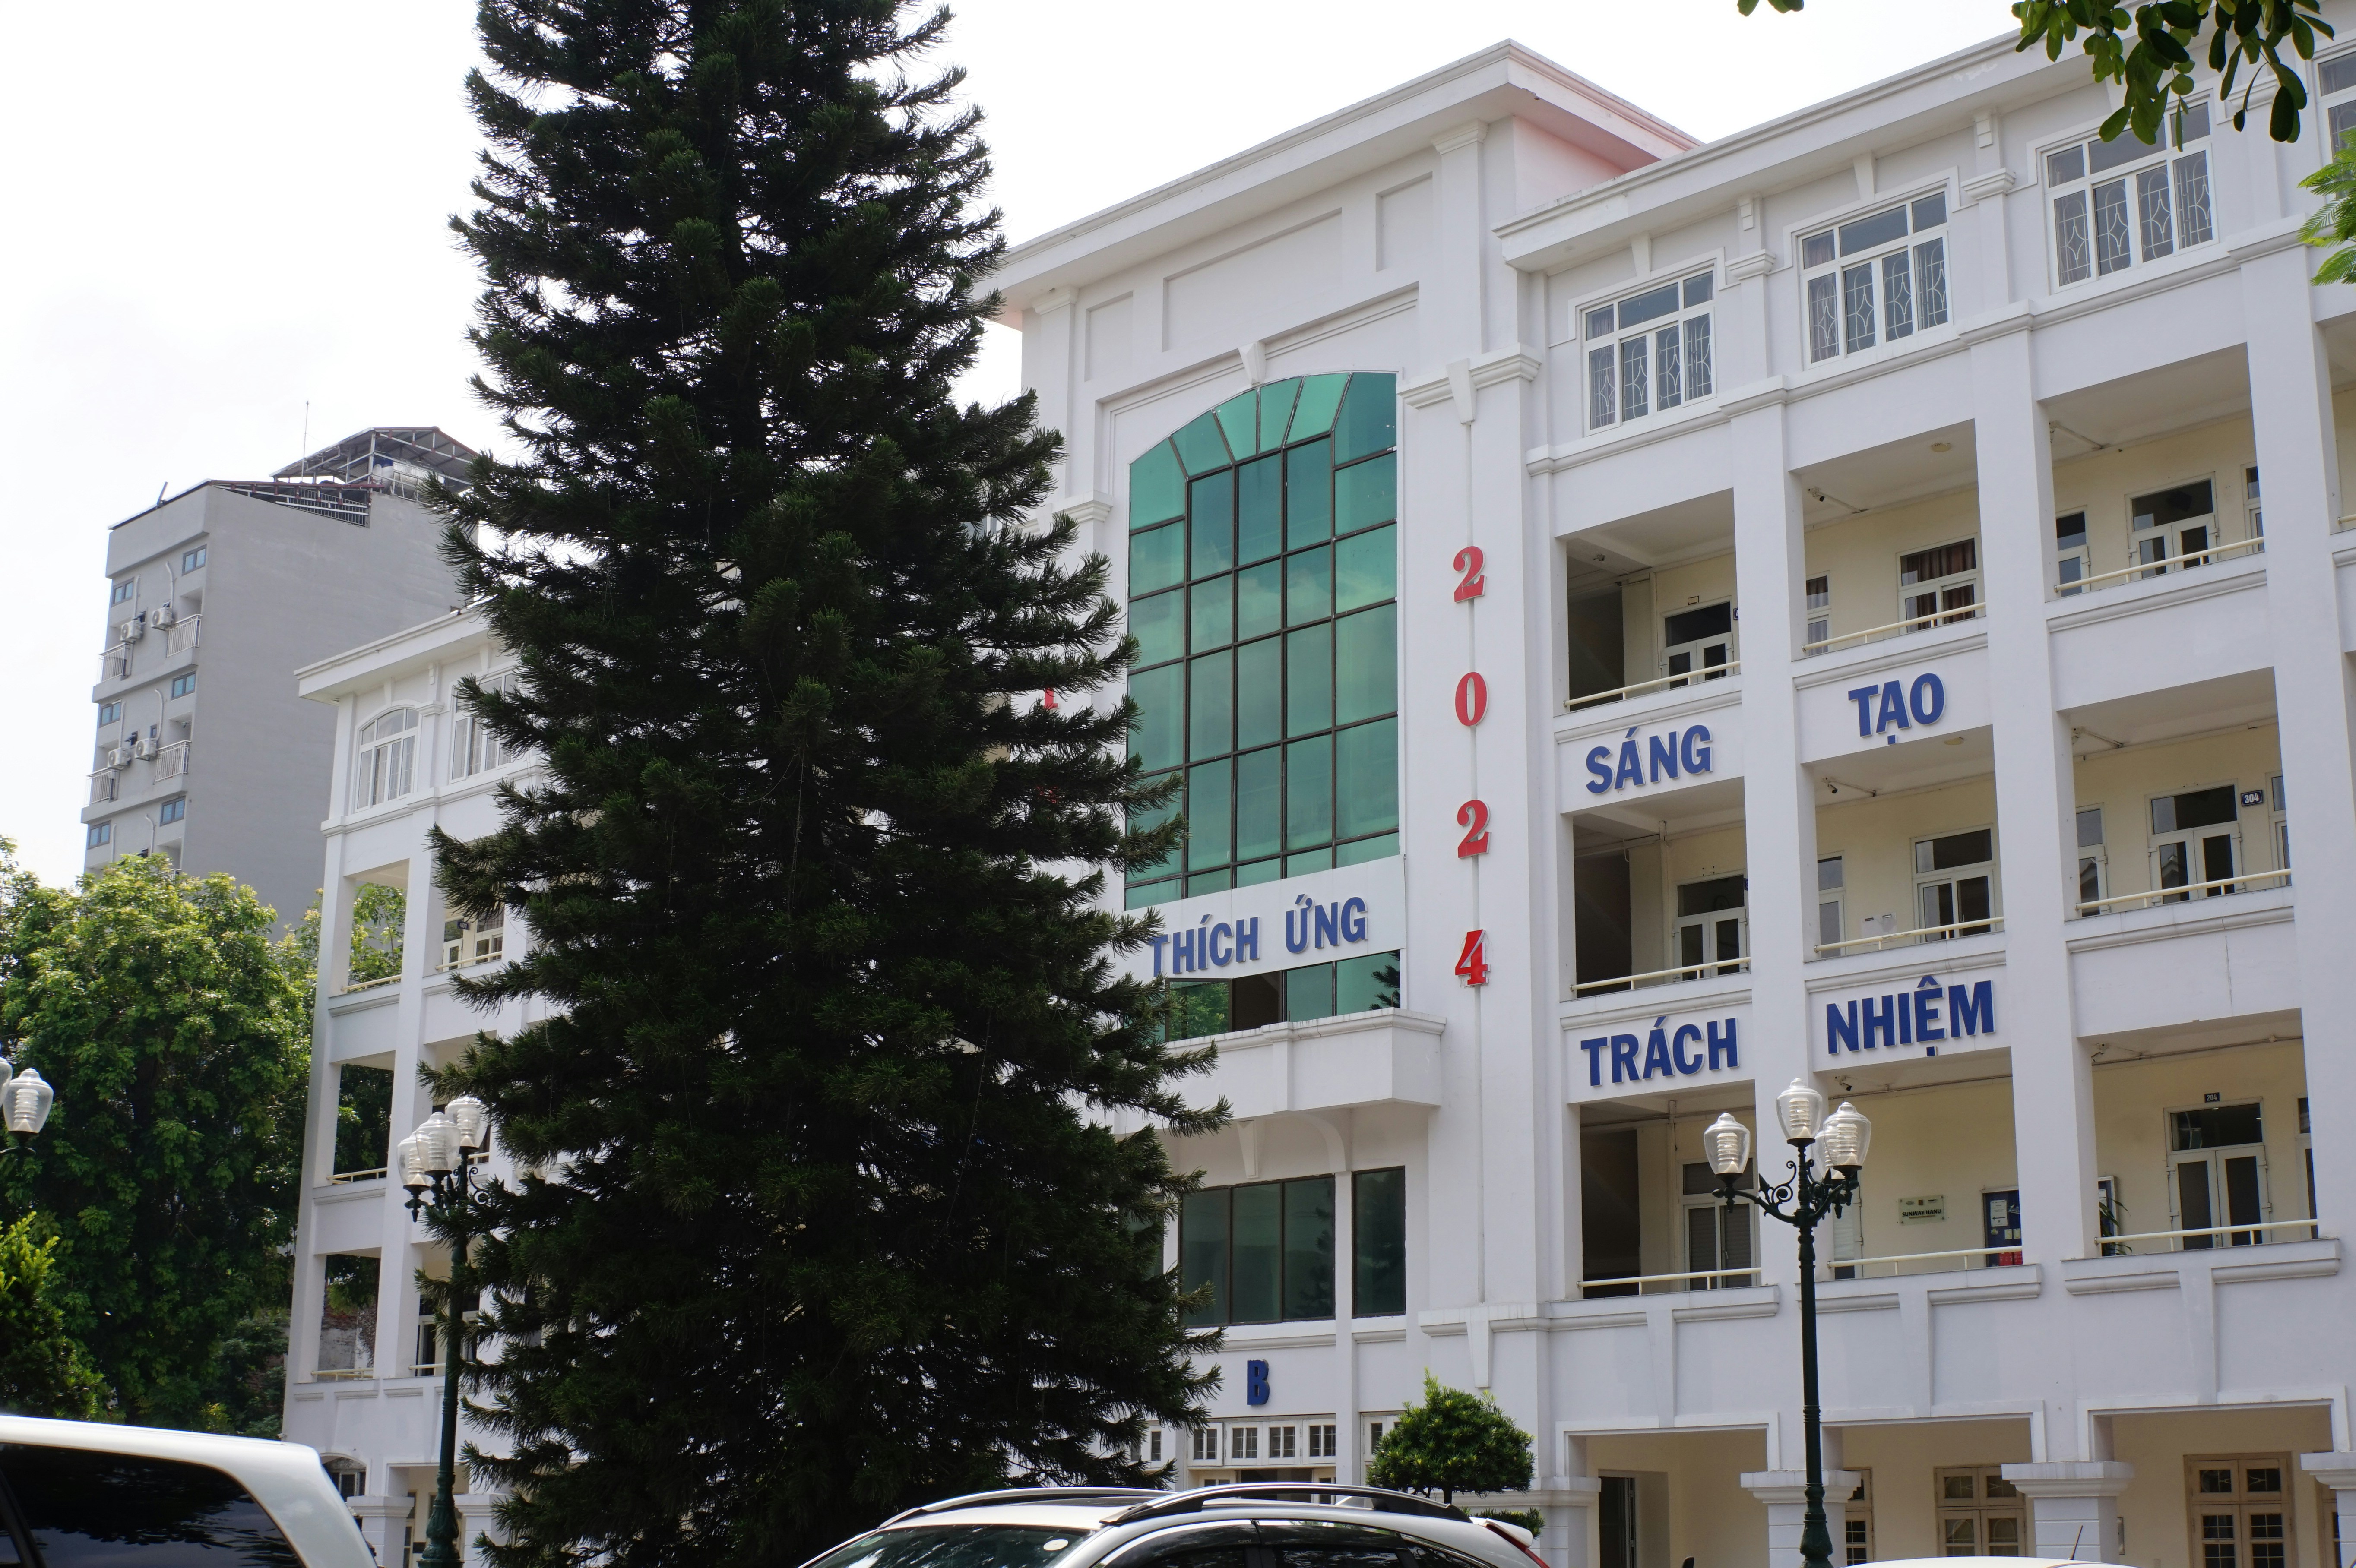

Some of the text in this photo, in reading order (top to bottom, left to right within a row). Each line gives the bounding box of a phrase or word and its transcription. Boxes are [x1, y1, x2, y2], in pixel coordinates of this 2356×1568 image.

[1586, 673, 1946, 794] SÁNG TẠO
[2244, 793, 2259, 804] 304
[1149, 893, 1368, 977] THÍCH ỨNG
[1581, 975, 1996, 1087] TRÁCH NHIỆM
[1247, 1359, 1270, 1406] B
